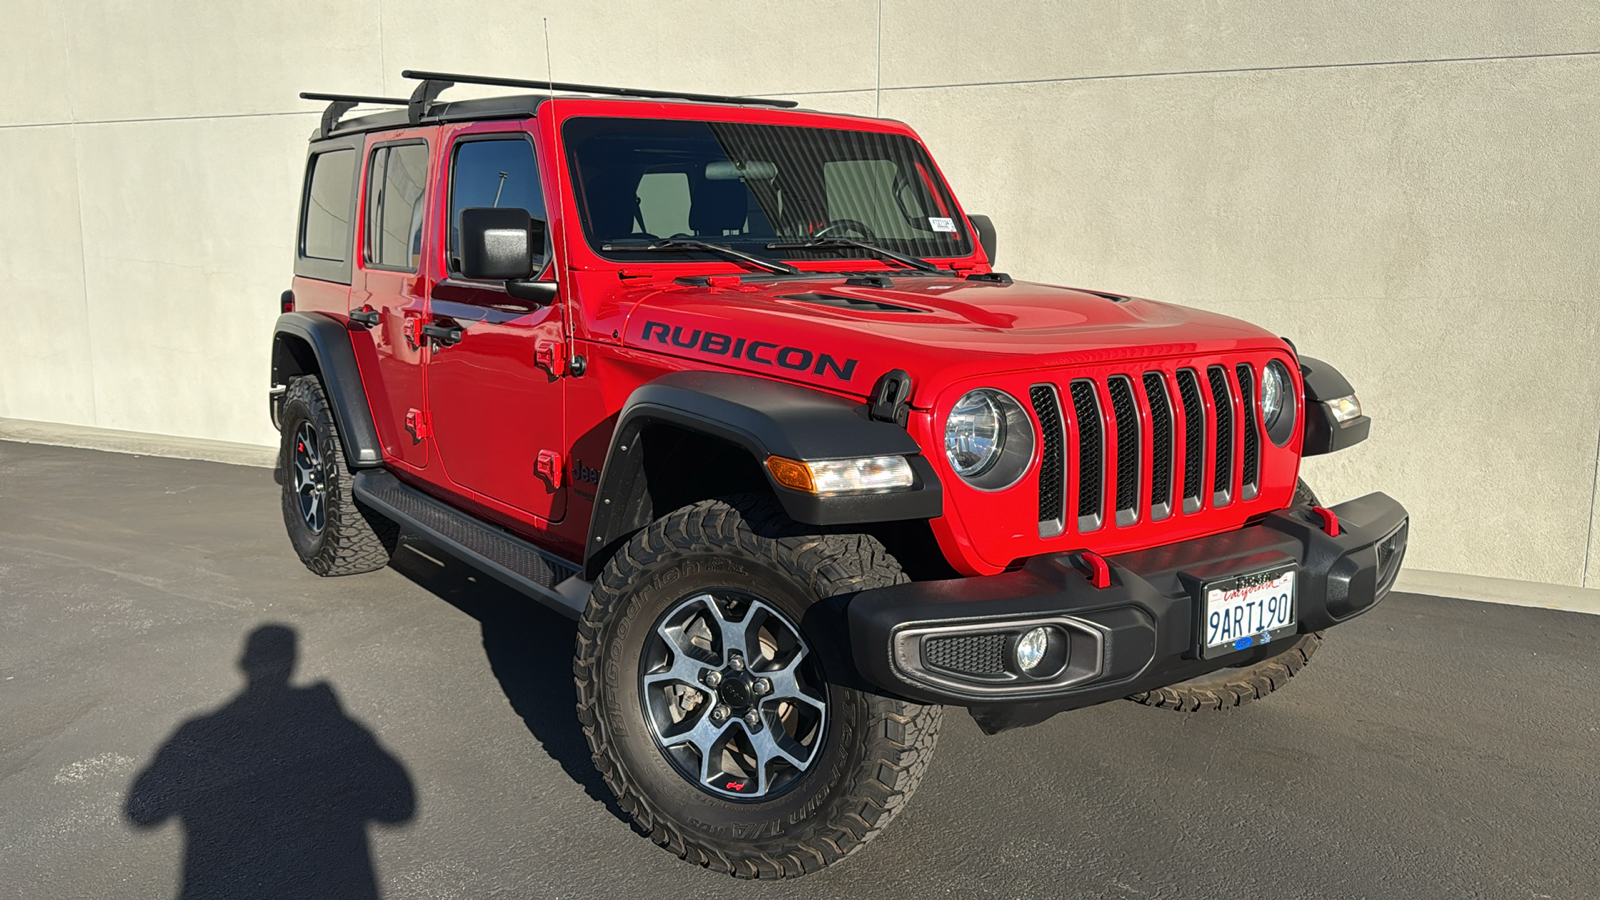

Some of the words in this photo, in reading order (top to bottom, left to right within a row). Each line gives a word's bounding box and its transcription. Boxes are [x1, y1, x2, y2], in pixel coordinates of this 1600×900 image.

[641, 320, 858, 381] RUBICON
[1208, 593, 1288, 644] 9ART190
[1223, 580, 1280, 602] California
[602, 557, 702, 738] BFGoodrich
